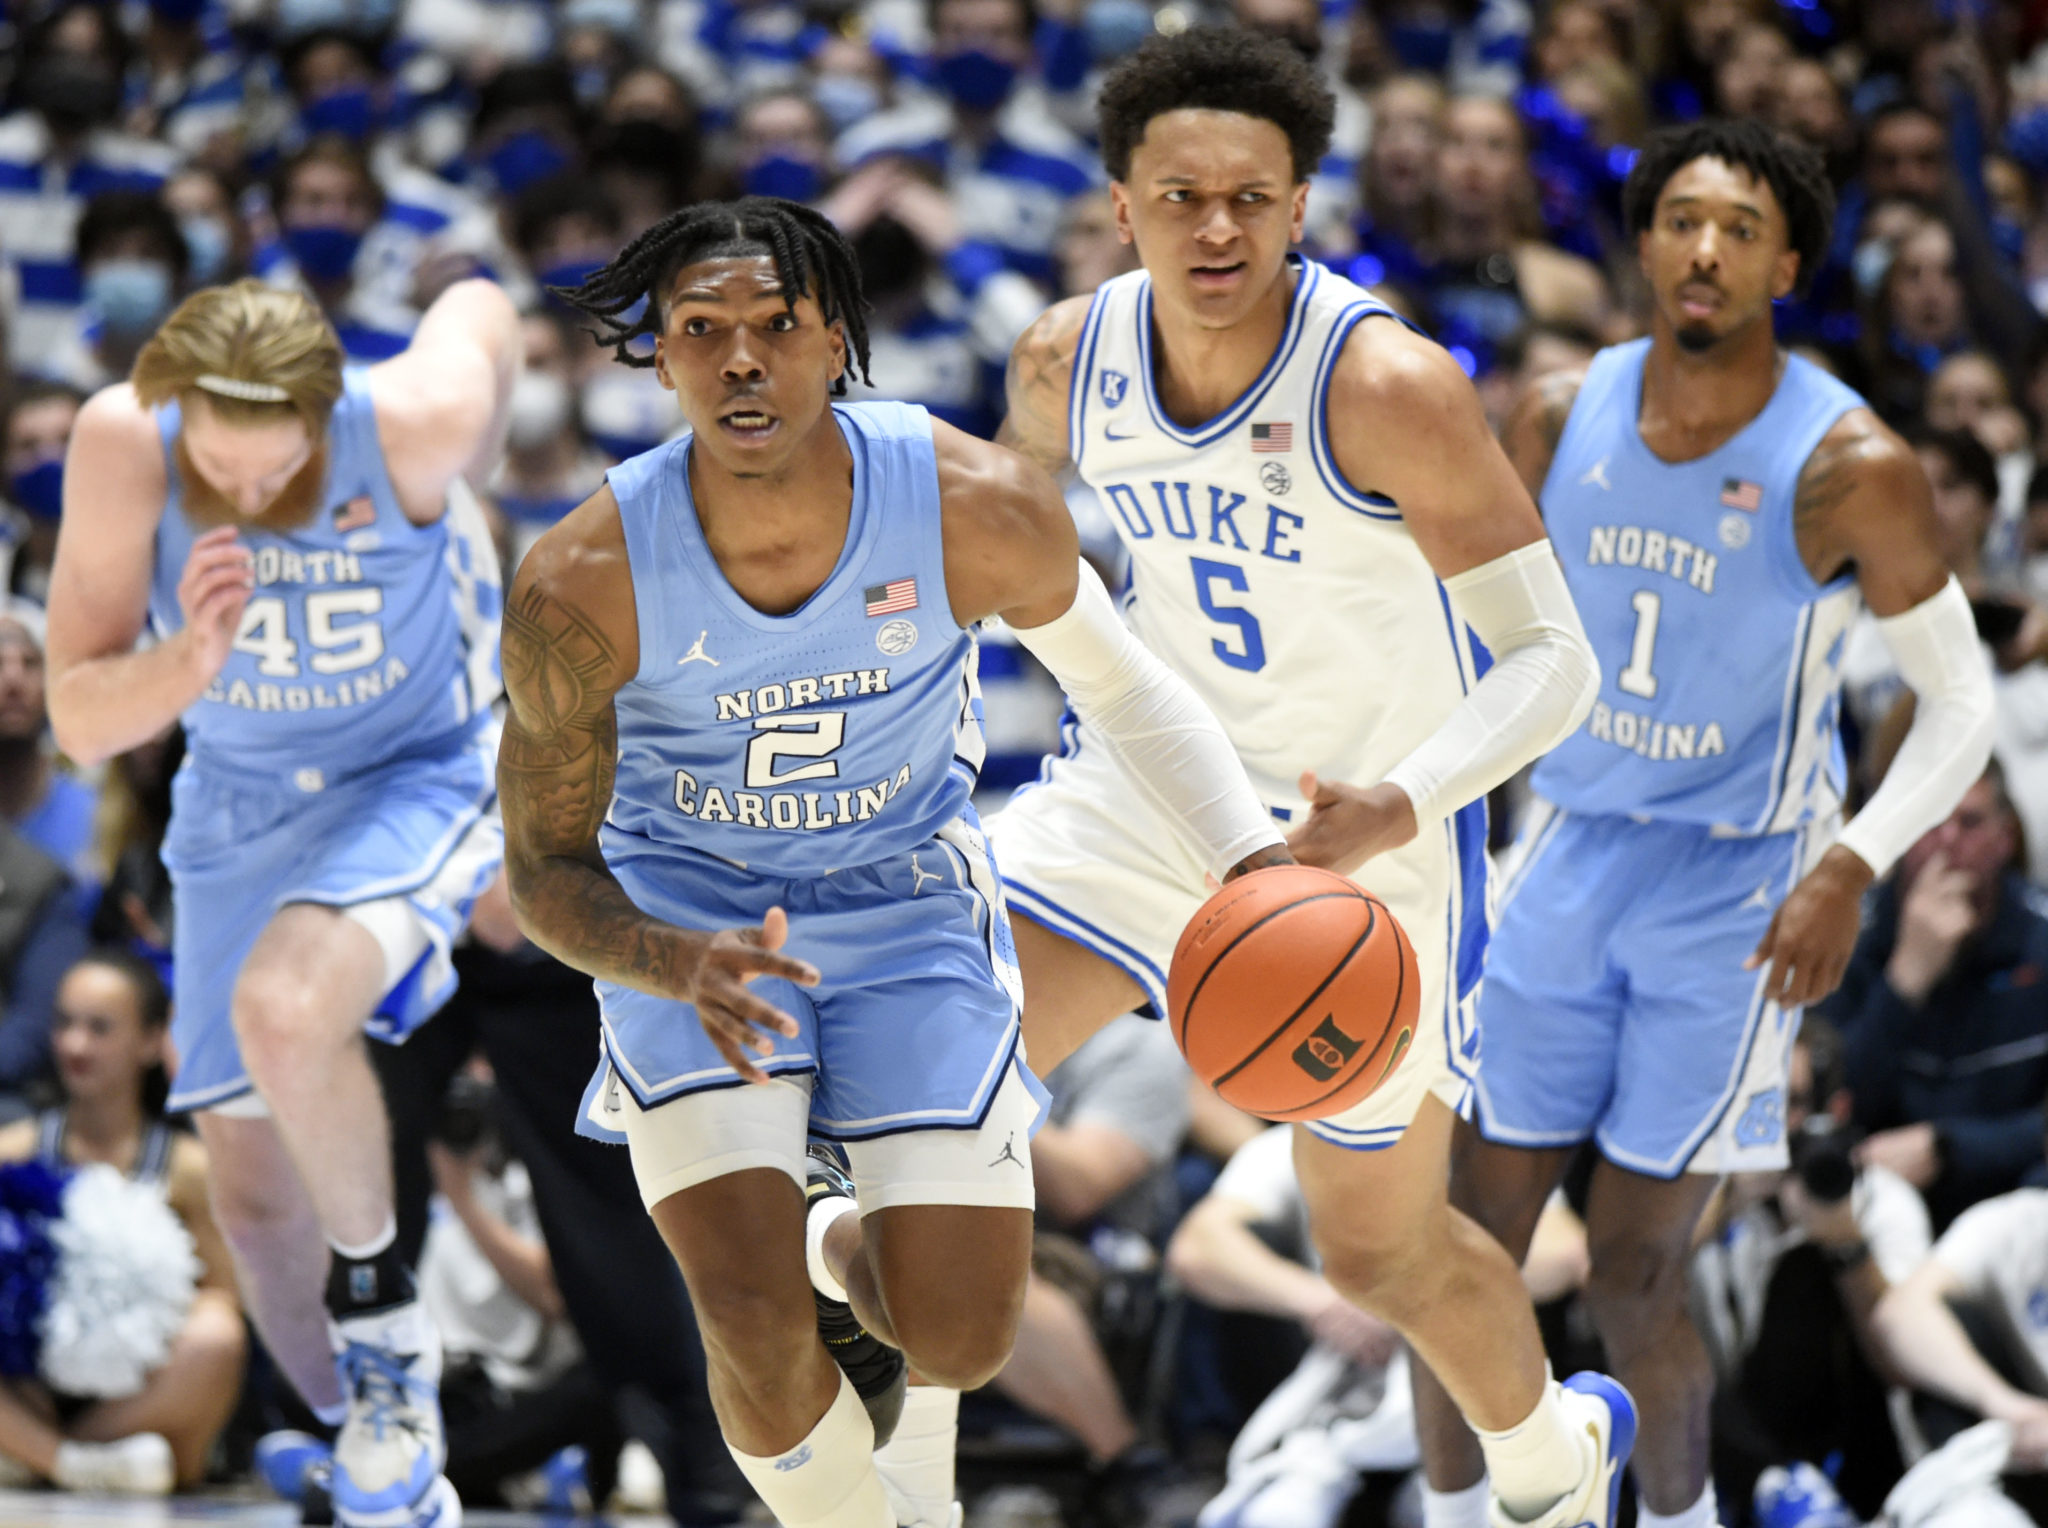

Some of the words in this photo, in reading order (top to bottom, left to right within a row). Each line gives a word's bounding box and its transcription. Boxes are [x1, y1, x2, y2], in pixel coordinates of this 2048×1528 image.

[1104, 481, 1304, 563] DUKE
[248, 546, 363, 586] ORTH
[1587, 526, 1718, 595] NORTH
[231, 587, 384, 677] 45
[1189, 556, 1266, 673] 5
[1618, 589, 1661, 699] 1
[715, 668, 890, 720] NORTH
[744, 712, 847, 788] 2
[674, 763, 912, 831] CAROLINA
